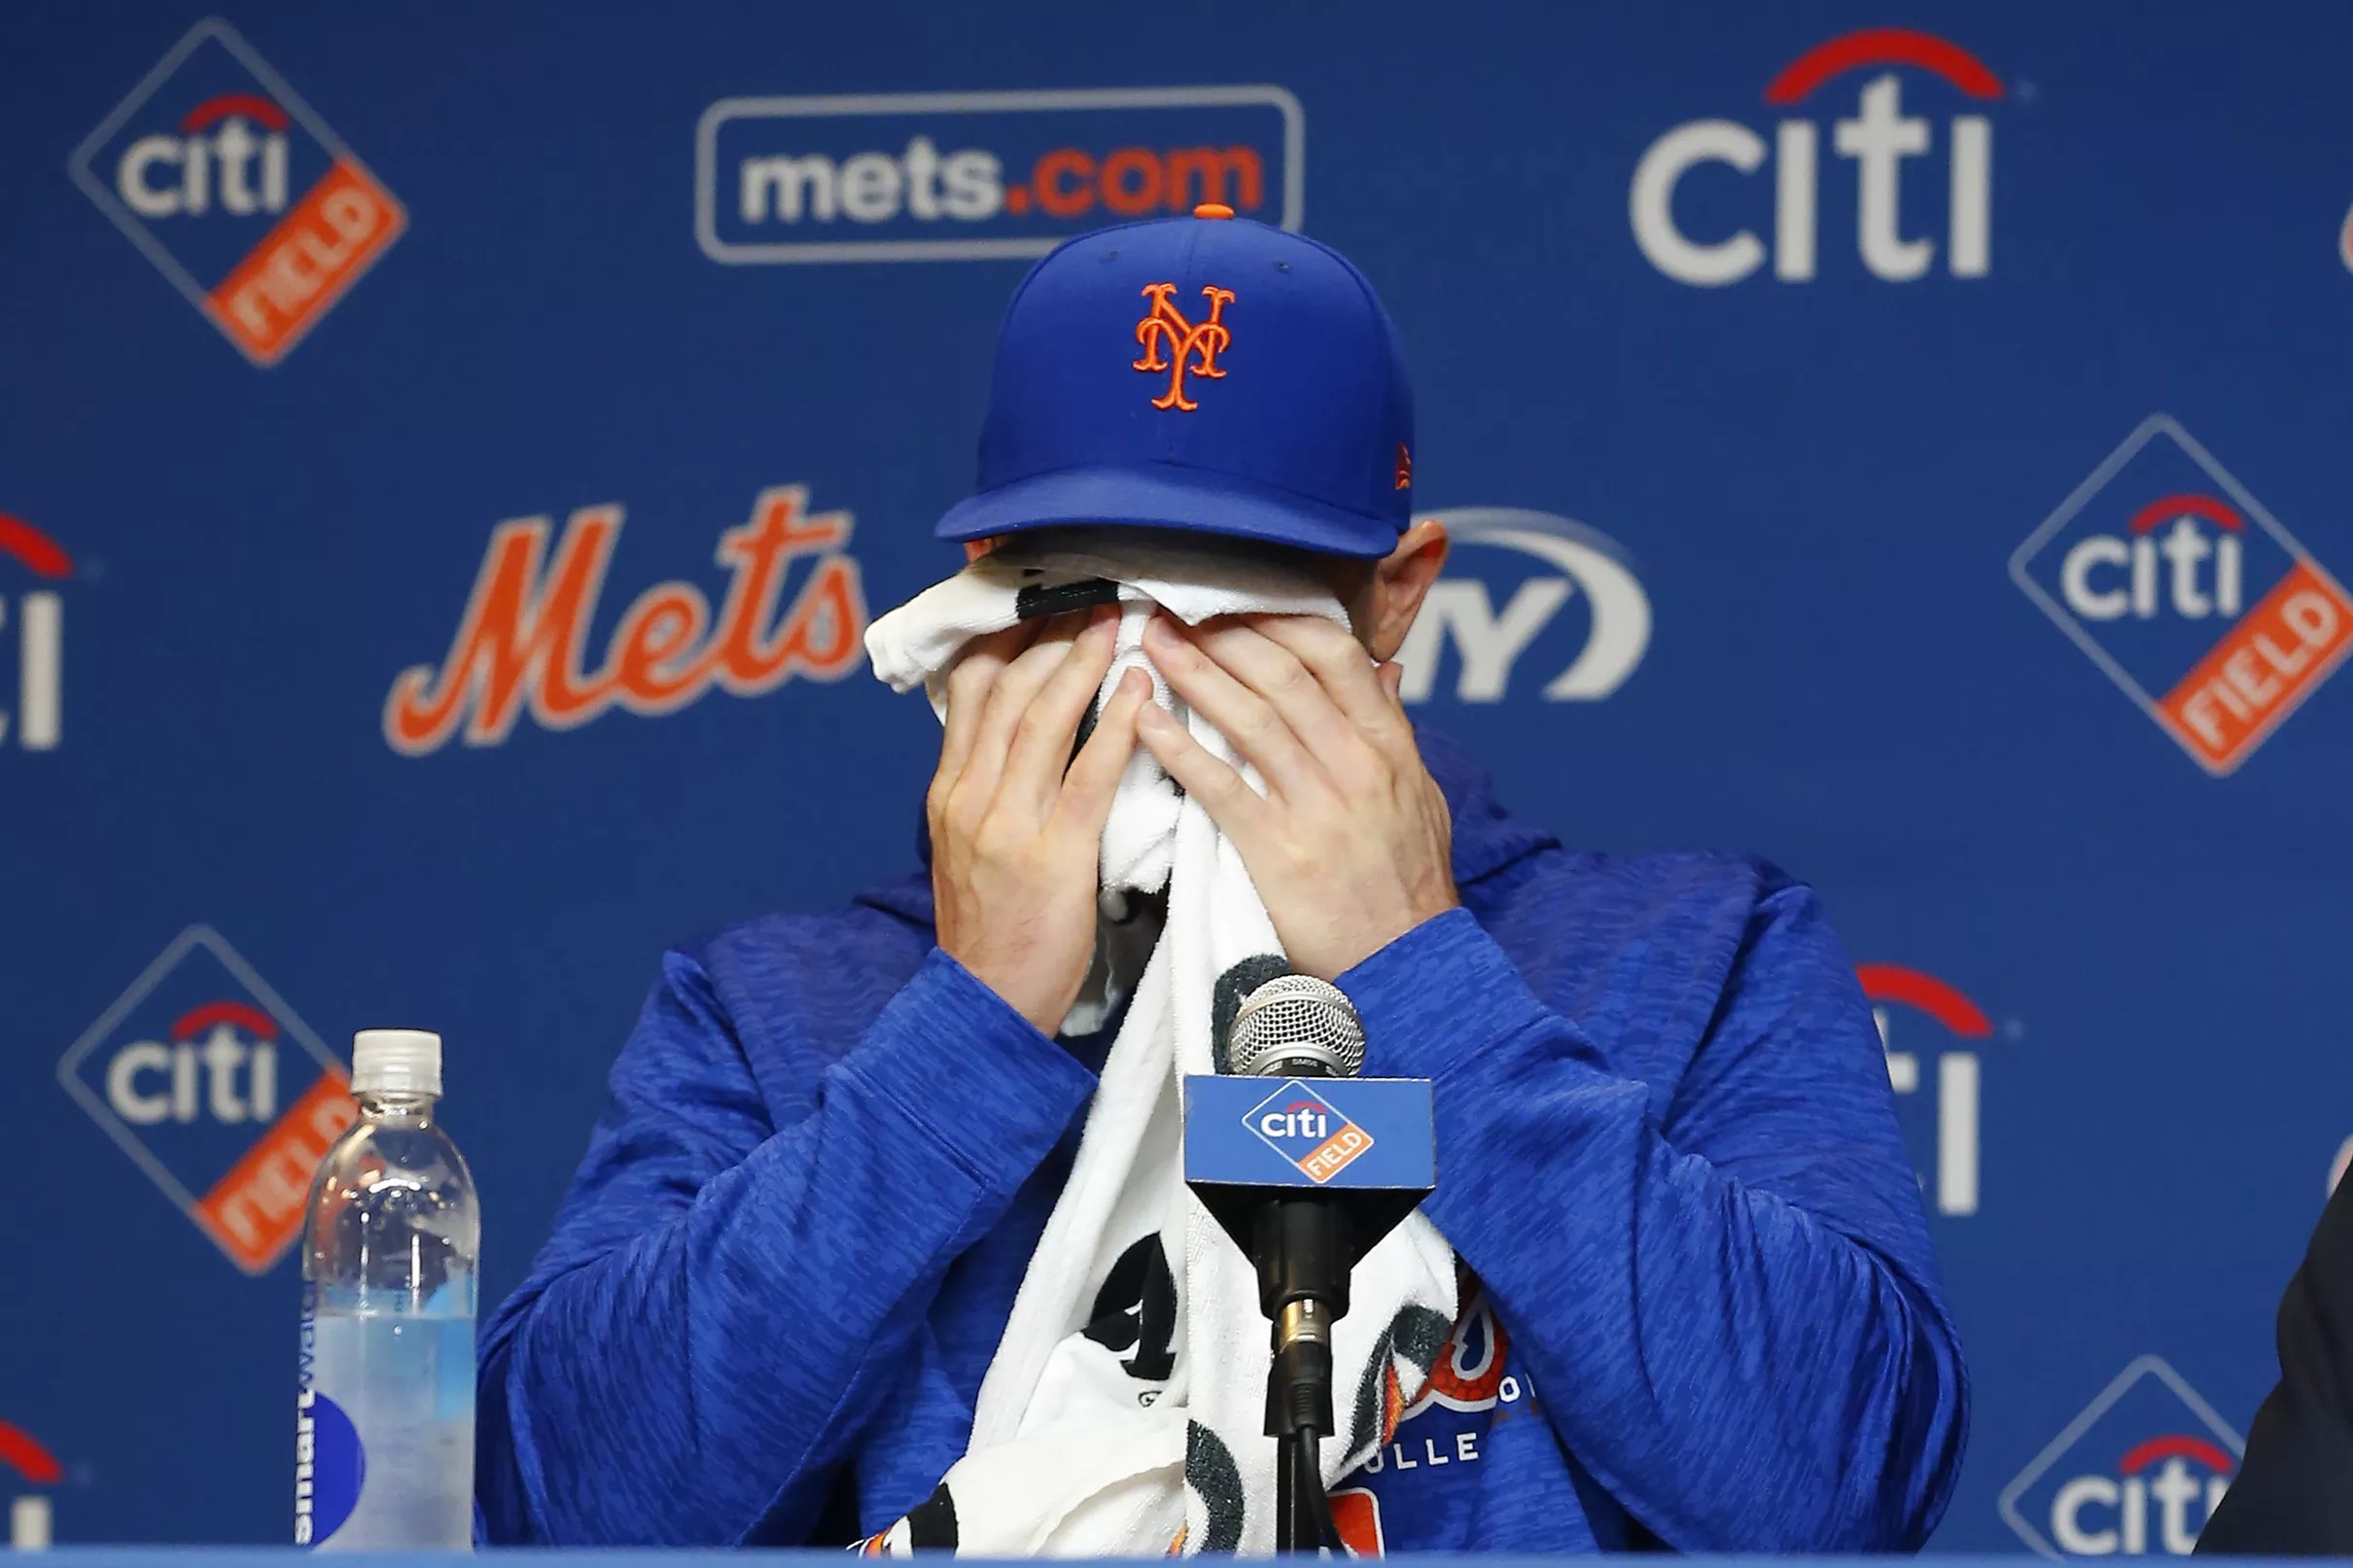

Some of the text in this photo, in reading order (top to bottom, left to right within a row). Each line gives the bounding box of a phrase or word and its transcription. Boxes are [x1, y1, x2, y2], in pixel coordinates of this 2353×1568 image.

[119, 116, 289, 217] citi
[742, 136, 1262, 222] mets.com
[1630, 73, 1991, 287] citi
[230, 185, 378, 338] FIELD
[1133, 282, 1236, 411] NY
[382, 484, 867, 756] Mets
[2060, 515, 2241, 620] citi
[2181, 590, 2338, 749] FIELD
[107, 1023, 278, 1125] citi
[1260, 1107, 1327, 1138] citi
[1306, 1132, 1363, 1176] FIELD
